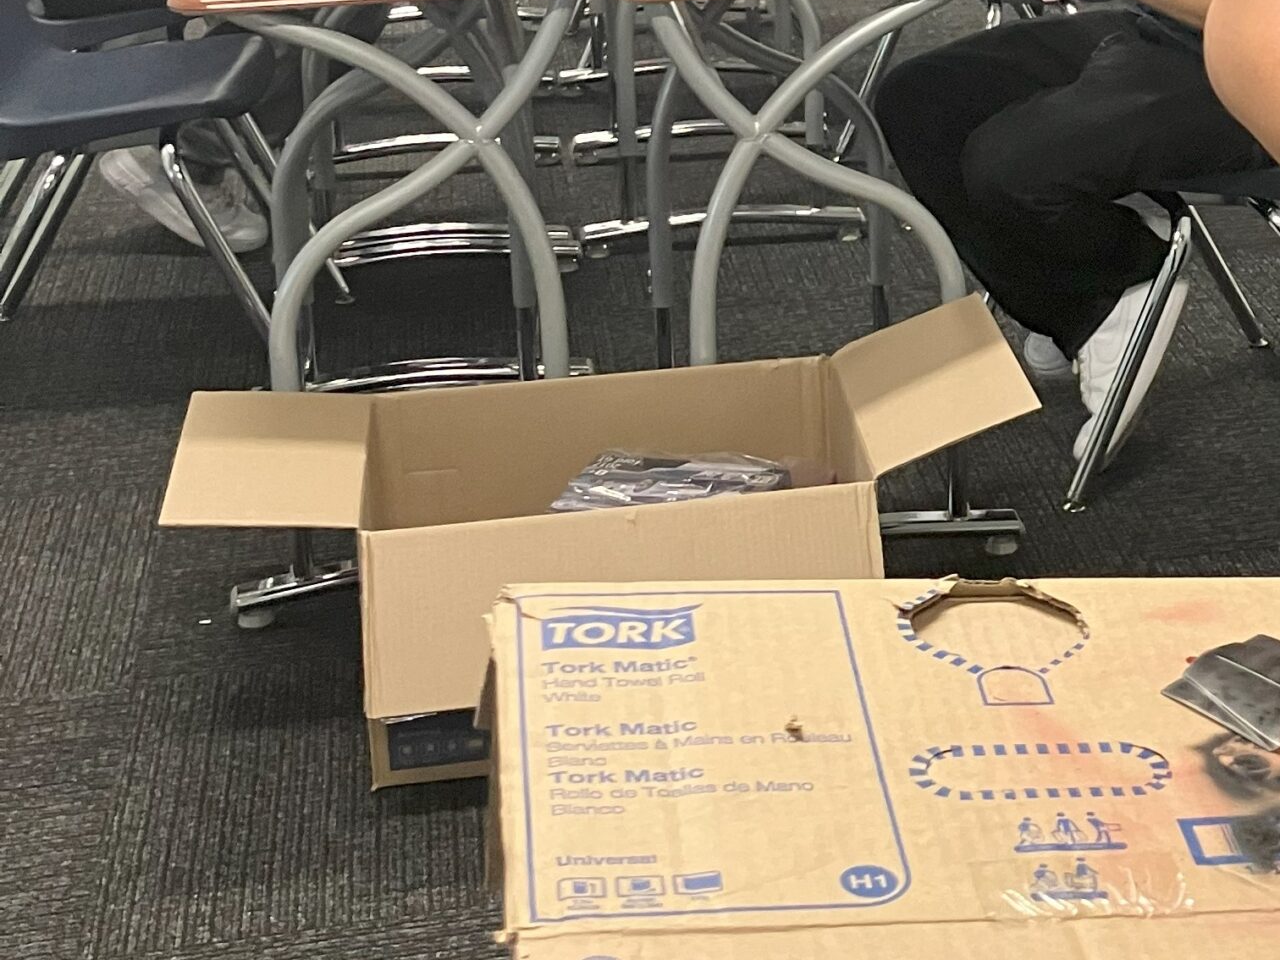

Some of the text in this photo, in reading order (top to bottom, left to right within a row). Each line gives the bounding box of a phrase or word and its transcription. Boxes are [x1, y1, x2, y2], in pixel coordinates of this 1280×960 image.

[546, 618, 687, 645] TORK
[541, 661, 606, 674] Tork
[542, 672, 705, 690] Hand Towel Roll
[542, 692, 601, 702] White
[545, 720, 698, 738] Tork Matic
[673, 735, 734, 748] Mains
[740, 734, 765, 745] en
[548, 756, 607, 768] Blanc
[548, 768, 705, 785] Tork Matic
[550, 781, 815, 801] Rollo de Toallas de Mano
[551, 805, 625, 817] Blanco
[556, 855, 657, 867] Universal
[849, 874, 888, 889] H1
